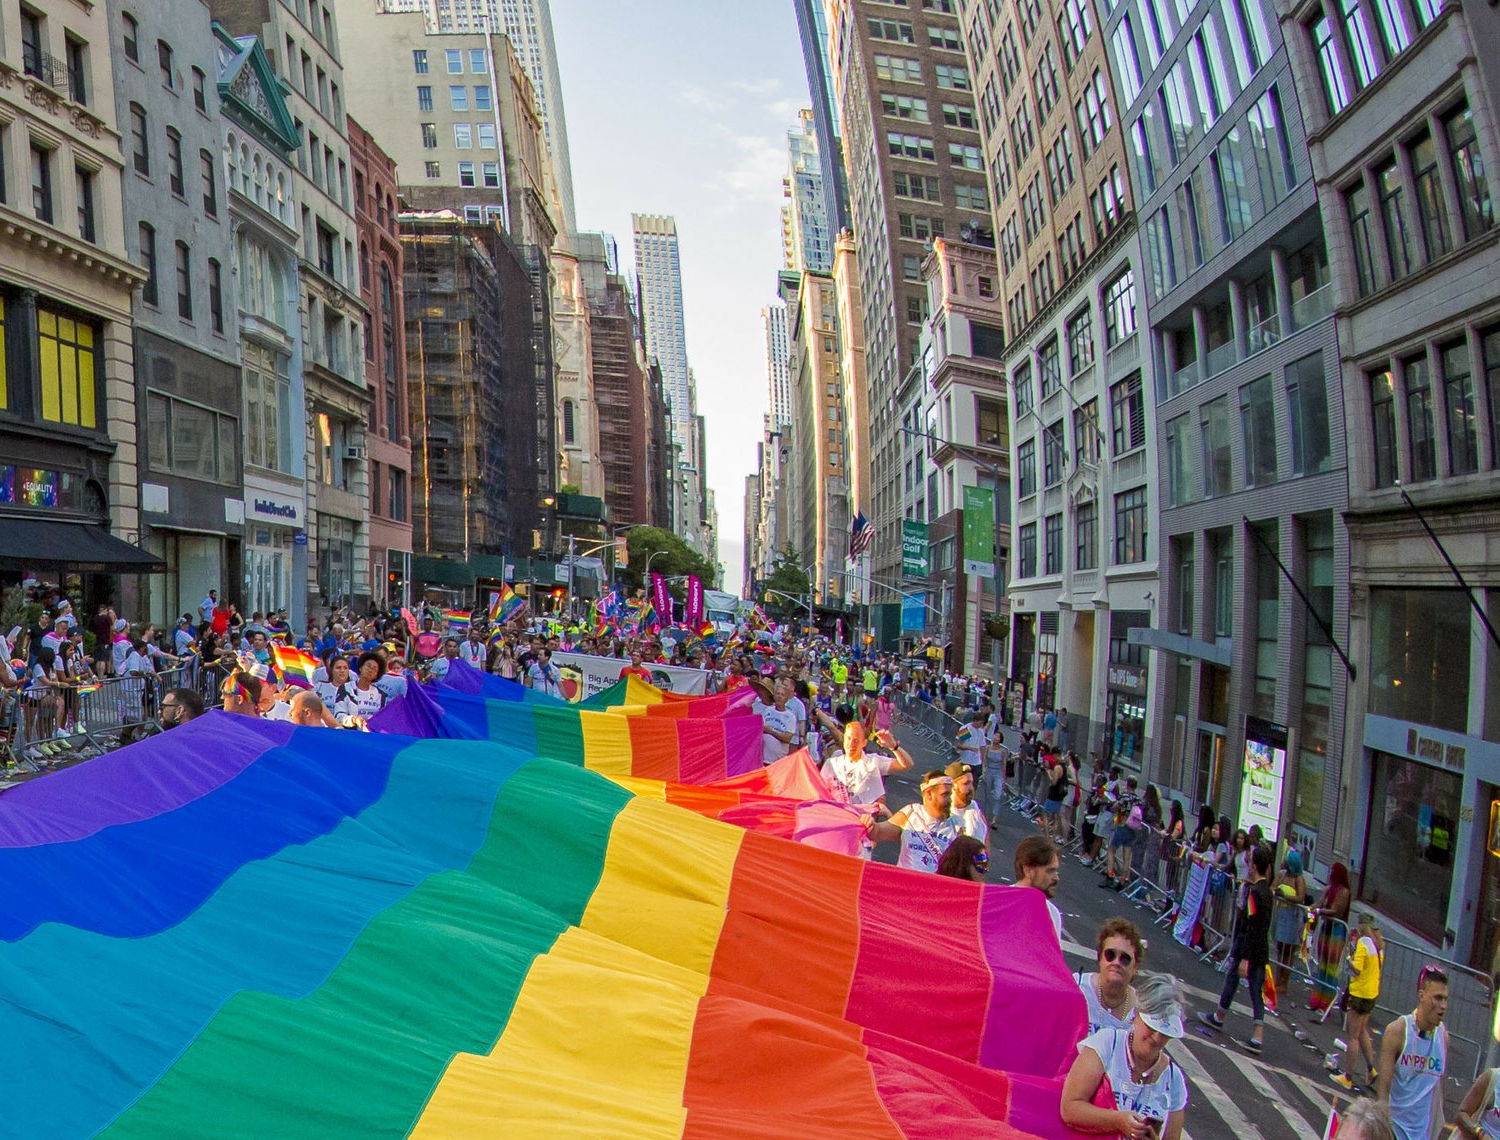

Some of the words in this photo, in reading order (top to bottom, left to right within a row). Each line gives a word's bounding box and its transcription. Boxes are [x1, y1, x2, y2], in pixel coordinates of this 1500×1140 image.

[26, 482, 53, 494] EQUALITY
[902, 534, 929, 546] Indoor
[903, 543, 920, 553] Golf
[589, 674, 601, 684] Big
[603, 676, 619, 687] App
[1114, 1091, 1128, 1106] EY
[1131, 1098, 1160, 1117] WES
